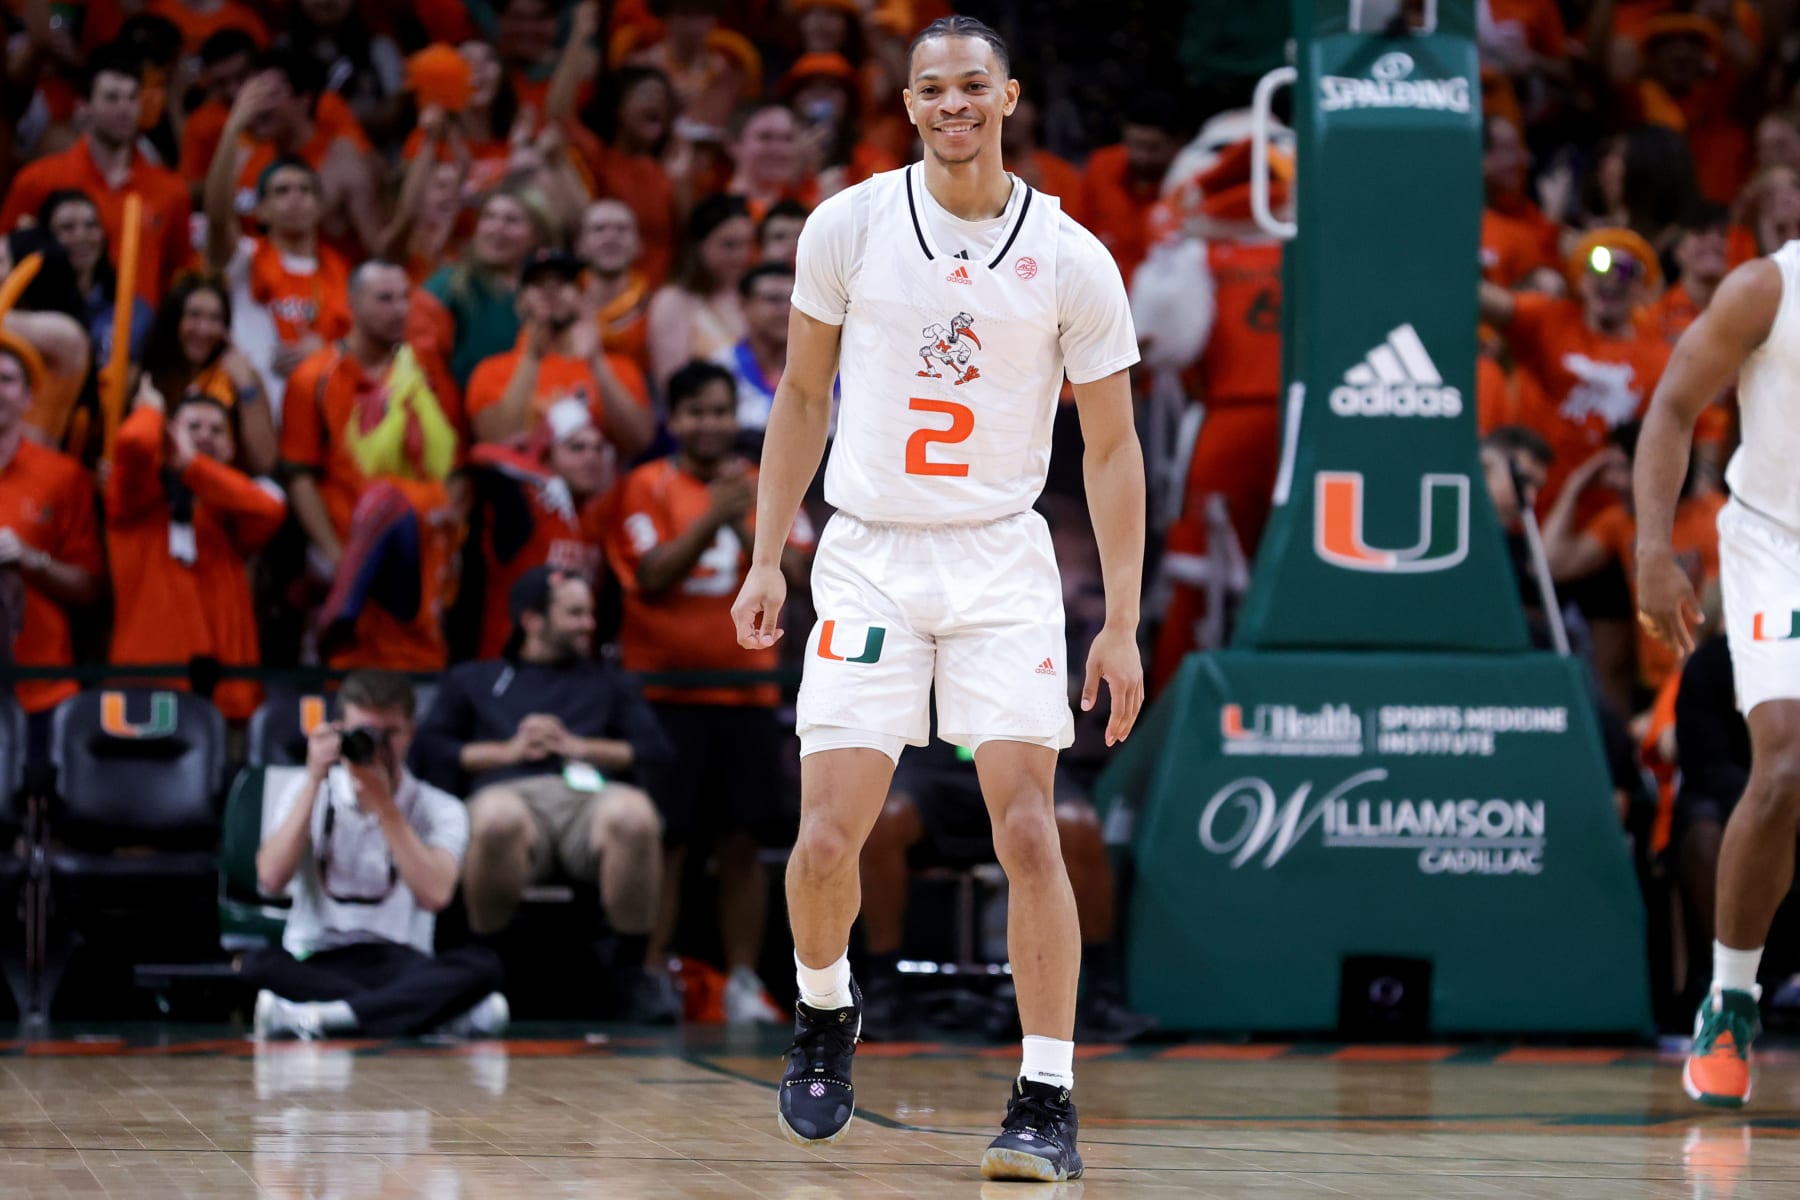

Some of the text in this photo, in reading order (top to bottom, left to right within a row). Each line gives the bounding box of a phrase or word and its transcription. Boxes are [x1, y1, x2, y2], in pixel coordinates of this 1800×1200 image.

[1320, 75, 1470, 113] SPALDING
[946, 275, 973, 286] adidas
[1329, 384, 1463, 418] adidas
[905, 397, 975, 477] 2
[1314, 471, 1470, 573] U
[816, 620, 886, 664] U
[100, 691, 177, 739] U
[1379, 706, 1567, 733] SPORTS MEDICINE
[1378, 732, 1495, 756] INSTITUTE
[1199, 767, 1545, 870] WILLIAMSON
[1418, 849, 1544, 874] CADILLAC
